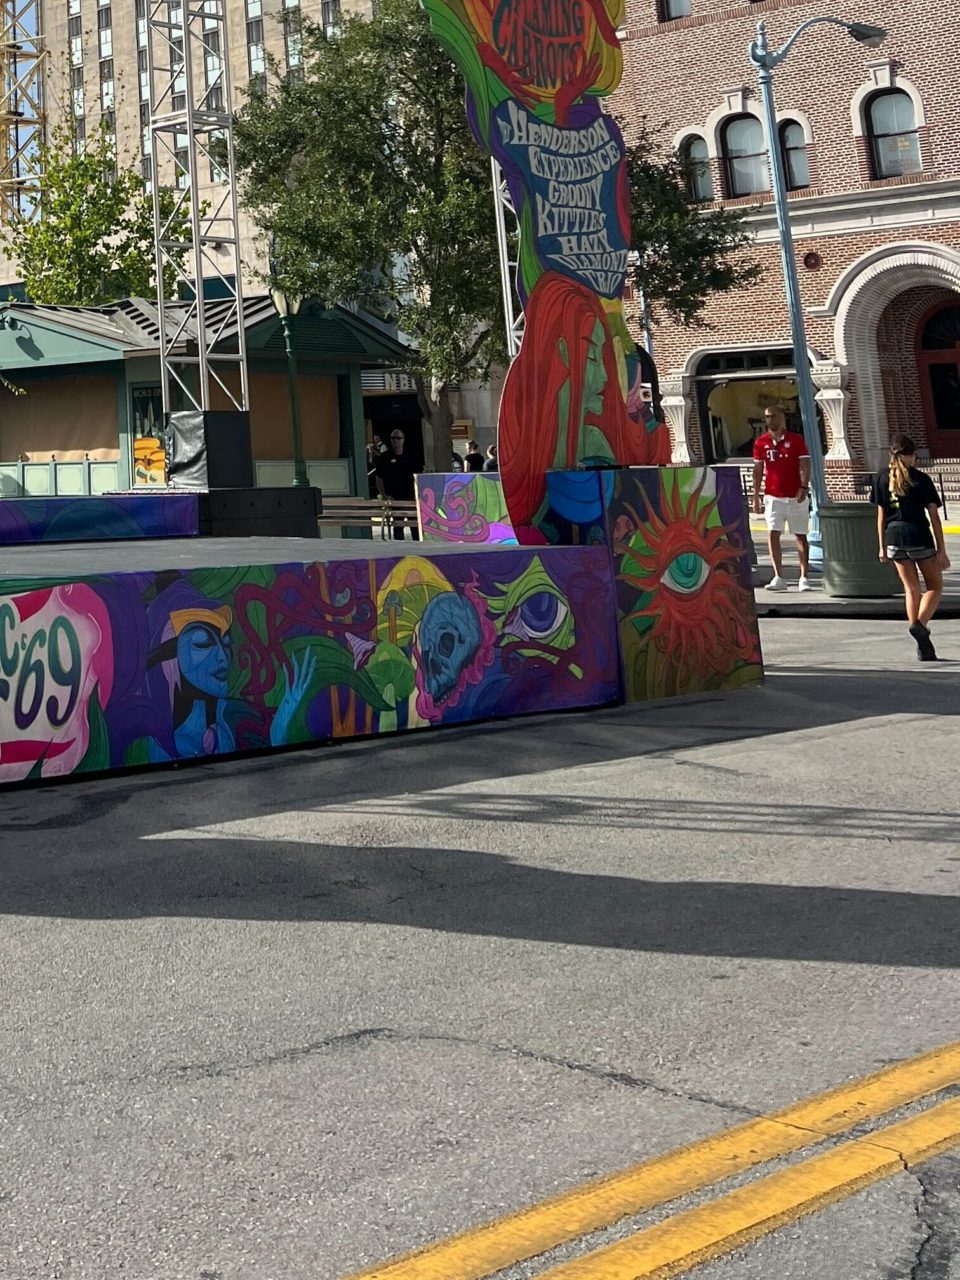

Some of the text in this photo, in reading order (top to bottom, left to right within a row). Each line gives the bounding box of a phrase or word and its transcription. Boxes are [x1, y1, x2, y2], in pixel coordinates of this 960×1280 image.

[507, 100, 610, 155] HENDERSON
[528, 140, 621, 182] EXPERIENCE
[549, 174, 603, 211] GROOVY
[536, 192, 606, 237] KITTIES
[557, 228, 614, 256] HAZY
[576, 270, 623, 294] TRIO
